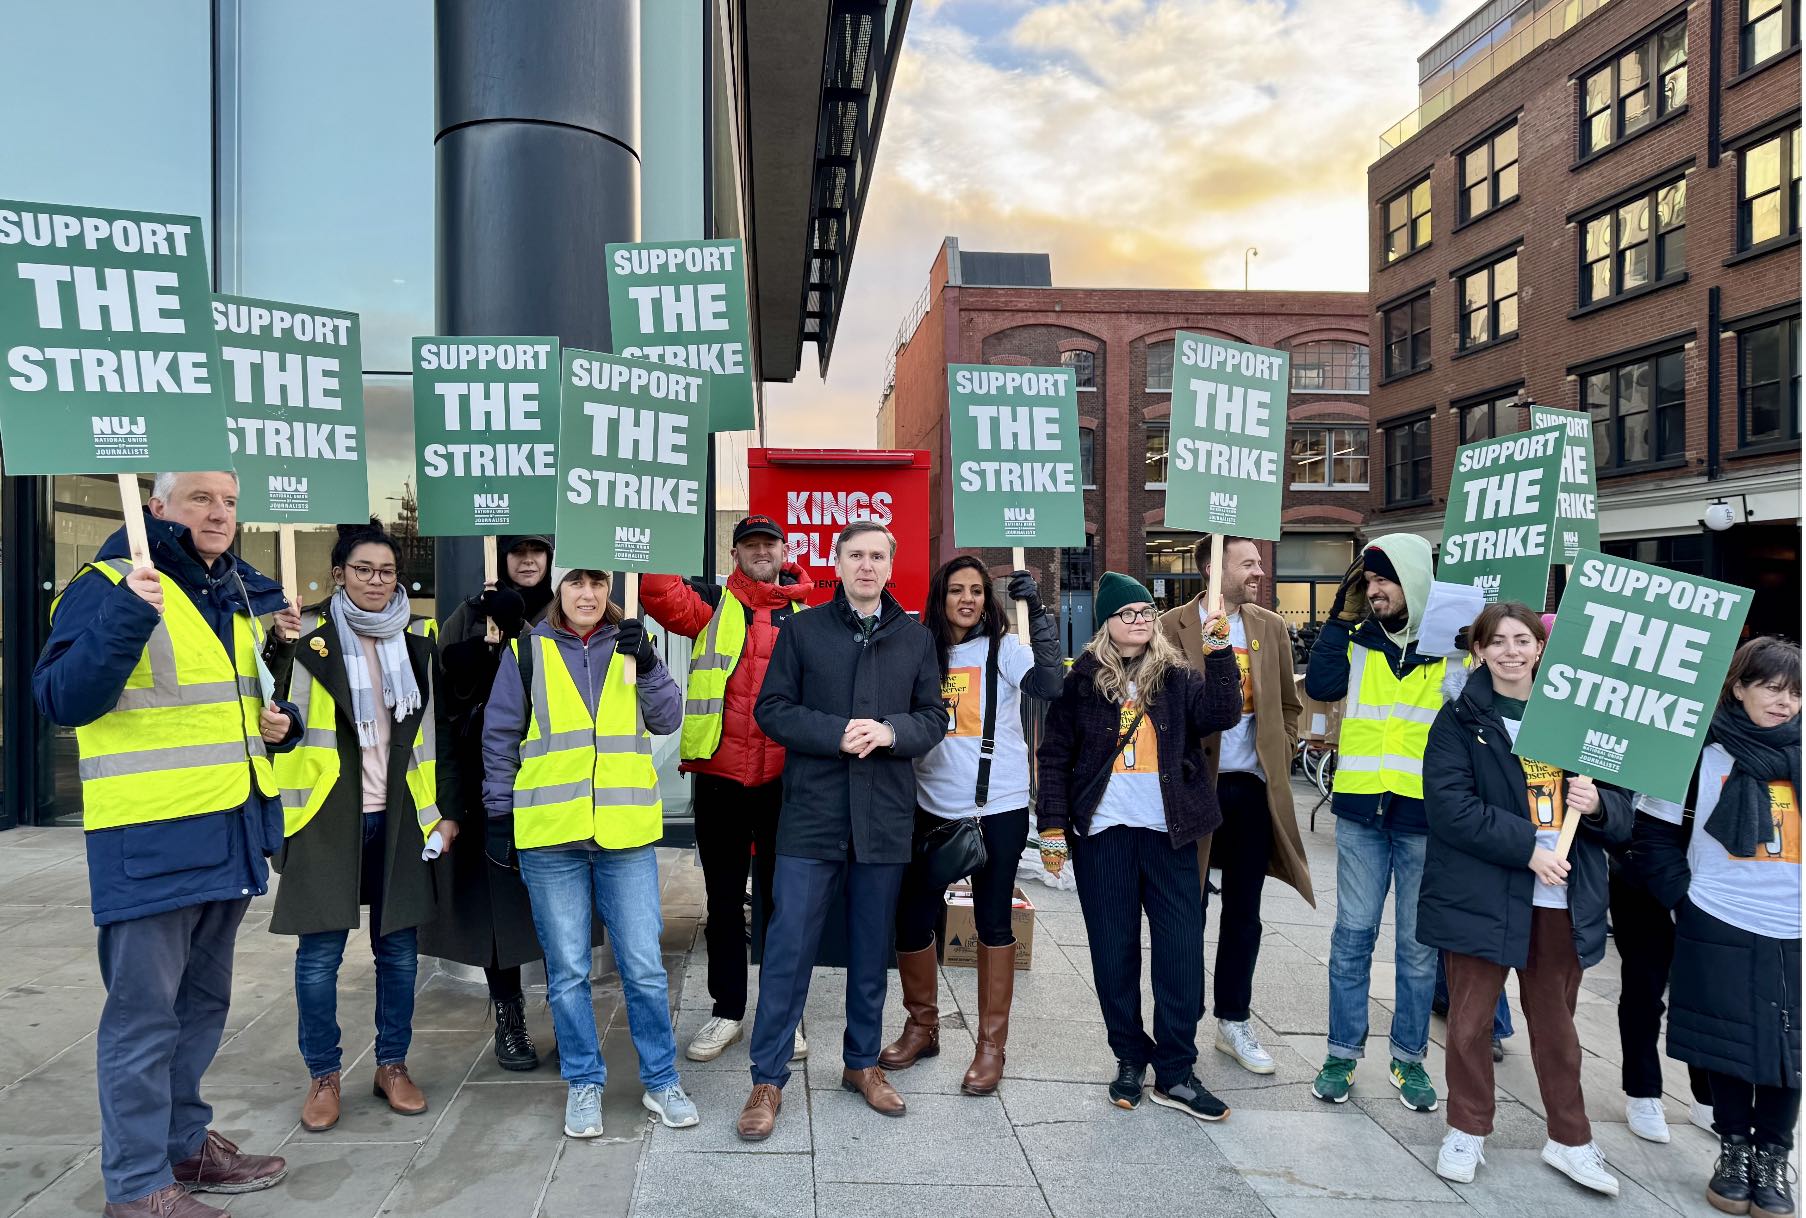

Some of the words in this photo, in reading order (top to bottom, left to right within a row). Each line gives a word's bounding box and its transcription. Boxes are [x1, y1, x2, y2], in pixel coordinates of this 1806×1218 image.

[0, 209, 191, 257] SUPPORT
[613, 246, 736, 275] SUPPORT
[17, 262, 186, 334] THE
[628, 284, 730, 334] THE
[211, 301, 351, 346] SUPPORT
[7, 346, 212, 394] STRIKE
[420, 344, 551, 370] SUPPORT
[1181, 339, 1283, 381] SUPPORT
[222, 346, 342, 411] THE
[571, 358, 703, 403] SUPPORT
[956, 370, 1068, 397] SUPPORT
[92, 416, 146, 434] NUJ
[435, 382, 541, 431] THE
[1189, 378, 1271, 438] THE
[583, 401, 689, 465] THE
[968, 405, 1062, 451] THE
[424, 444, 555, 477] STRIKE
[1175, 438, 1278, 483] STRIKE
[1458, 431, 1560, 473] SUPPORT
[1560, 445, 1589, 484] HE
[268, 475, 308, 492] NUJ
[566, 468, 698, 515] STRIKE
[960, 461, 1076, 493] STRIKE
[1463, 467, 1543, 523] THE
[473, 493, 509, 508] NUJ
[787, 491, 893, 526] KINGS
[1003, 507, 1035, 521] NUJ
[1210, 491, 1238, 508] NUJ
[615, 526, 651, 543] NUJ
[1444, 523, 1547, 565] STRIKE
[1474, 574, 1502, 588] NUJ
[1579, 559, 1741, 621] SUPPORT
[1581, 601, 1711, 685] THE
[1543, 663, 1705, 738] STRIKE
[1578, 754, 1621, 770] JOURNALISTS
[1582, 745, 1606, 756] NATIONAL
[1584, 729, 1629, 754] NUJ
[1528, 764, 1548, 773] The
